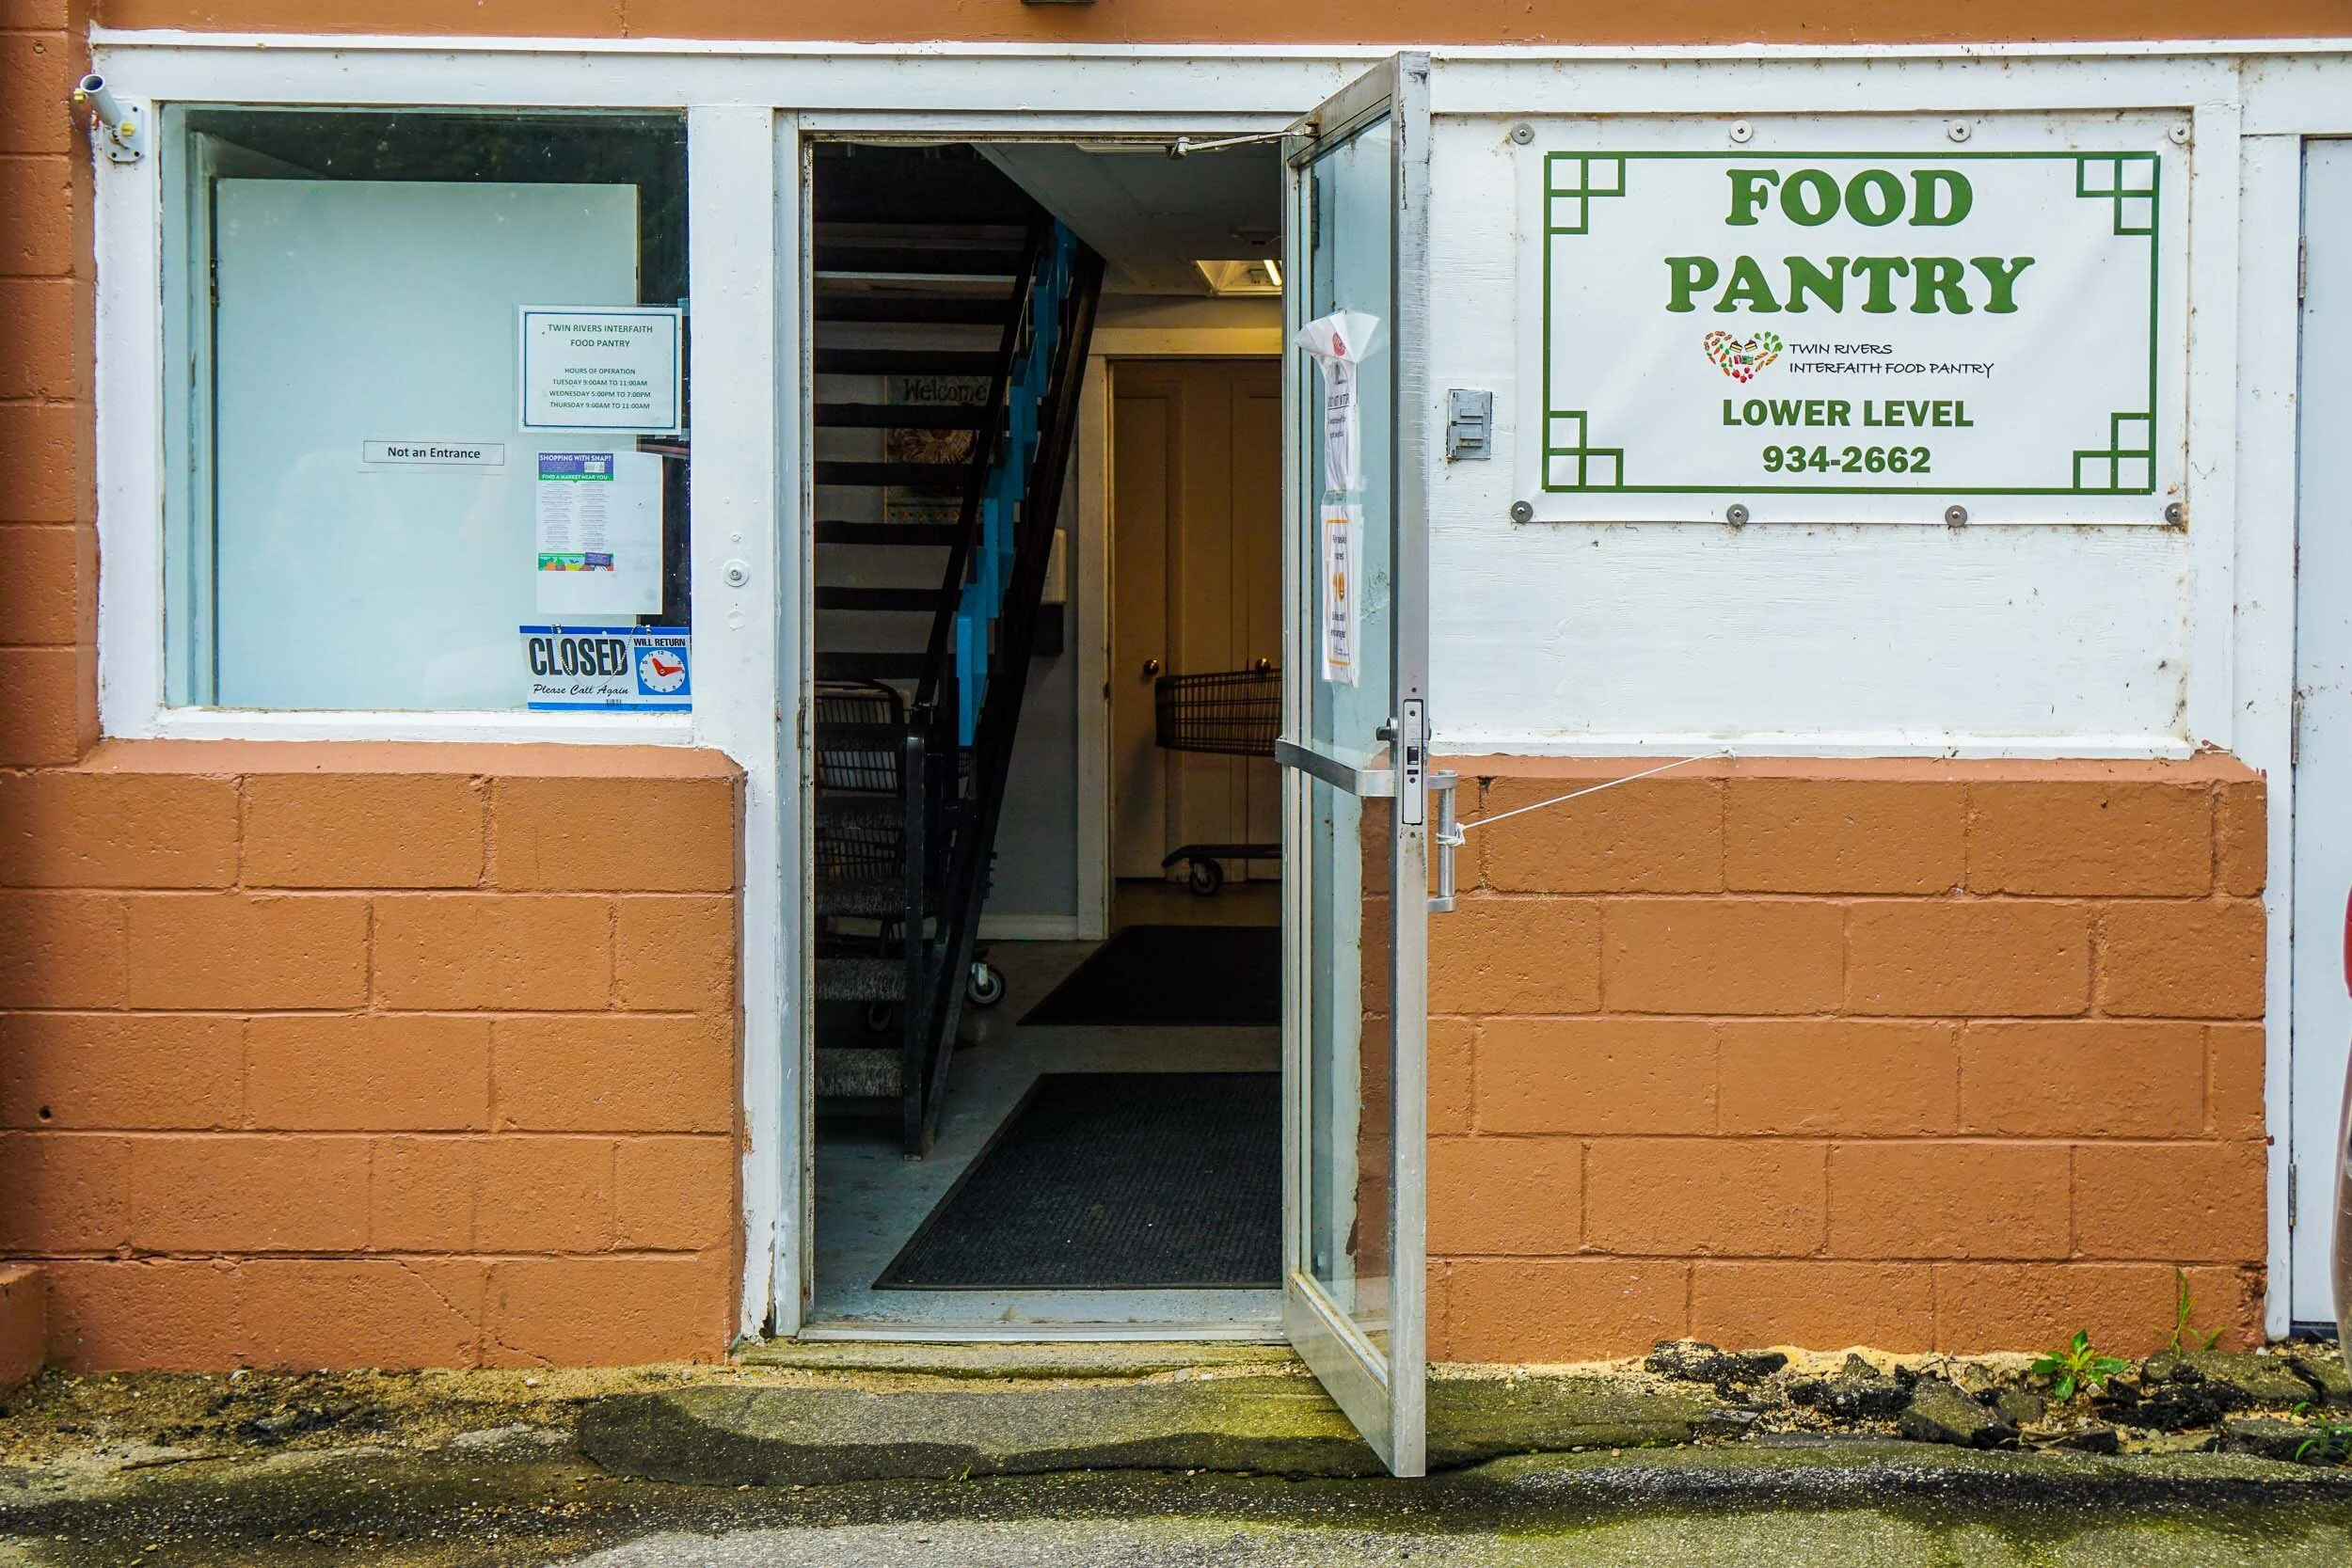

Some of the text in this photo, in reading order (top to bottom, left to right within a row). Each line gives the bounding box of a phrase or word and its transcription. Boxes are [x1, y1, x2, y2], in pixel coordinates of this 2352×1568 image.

[1725, 167, 1974, 228] FOOD
[1664, 255, 2035, 314] PANTRY
[605, 325, 653, 333] INTERFAITH
[1790, 342, 1893, 356] TWIN RIVERS
[1790, 361, 1994, 379] INTERFAITH FOOD PANTRY
[903, 378, 987, 402] Welcome
[1723, 399, 1974, 428] LOWER LEVEL
[388, 447, 481, 459] Not an Entrance
[1763, 445, 1931, 474] 934-2662
[529, 638, 628, 676] CLOSED
[533, 684, 628, 697] Please Call Again
